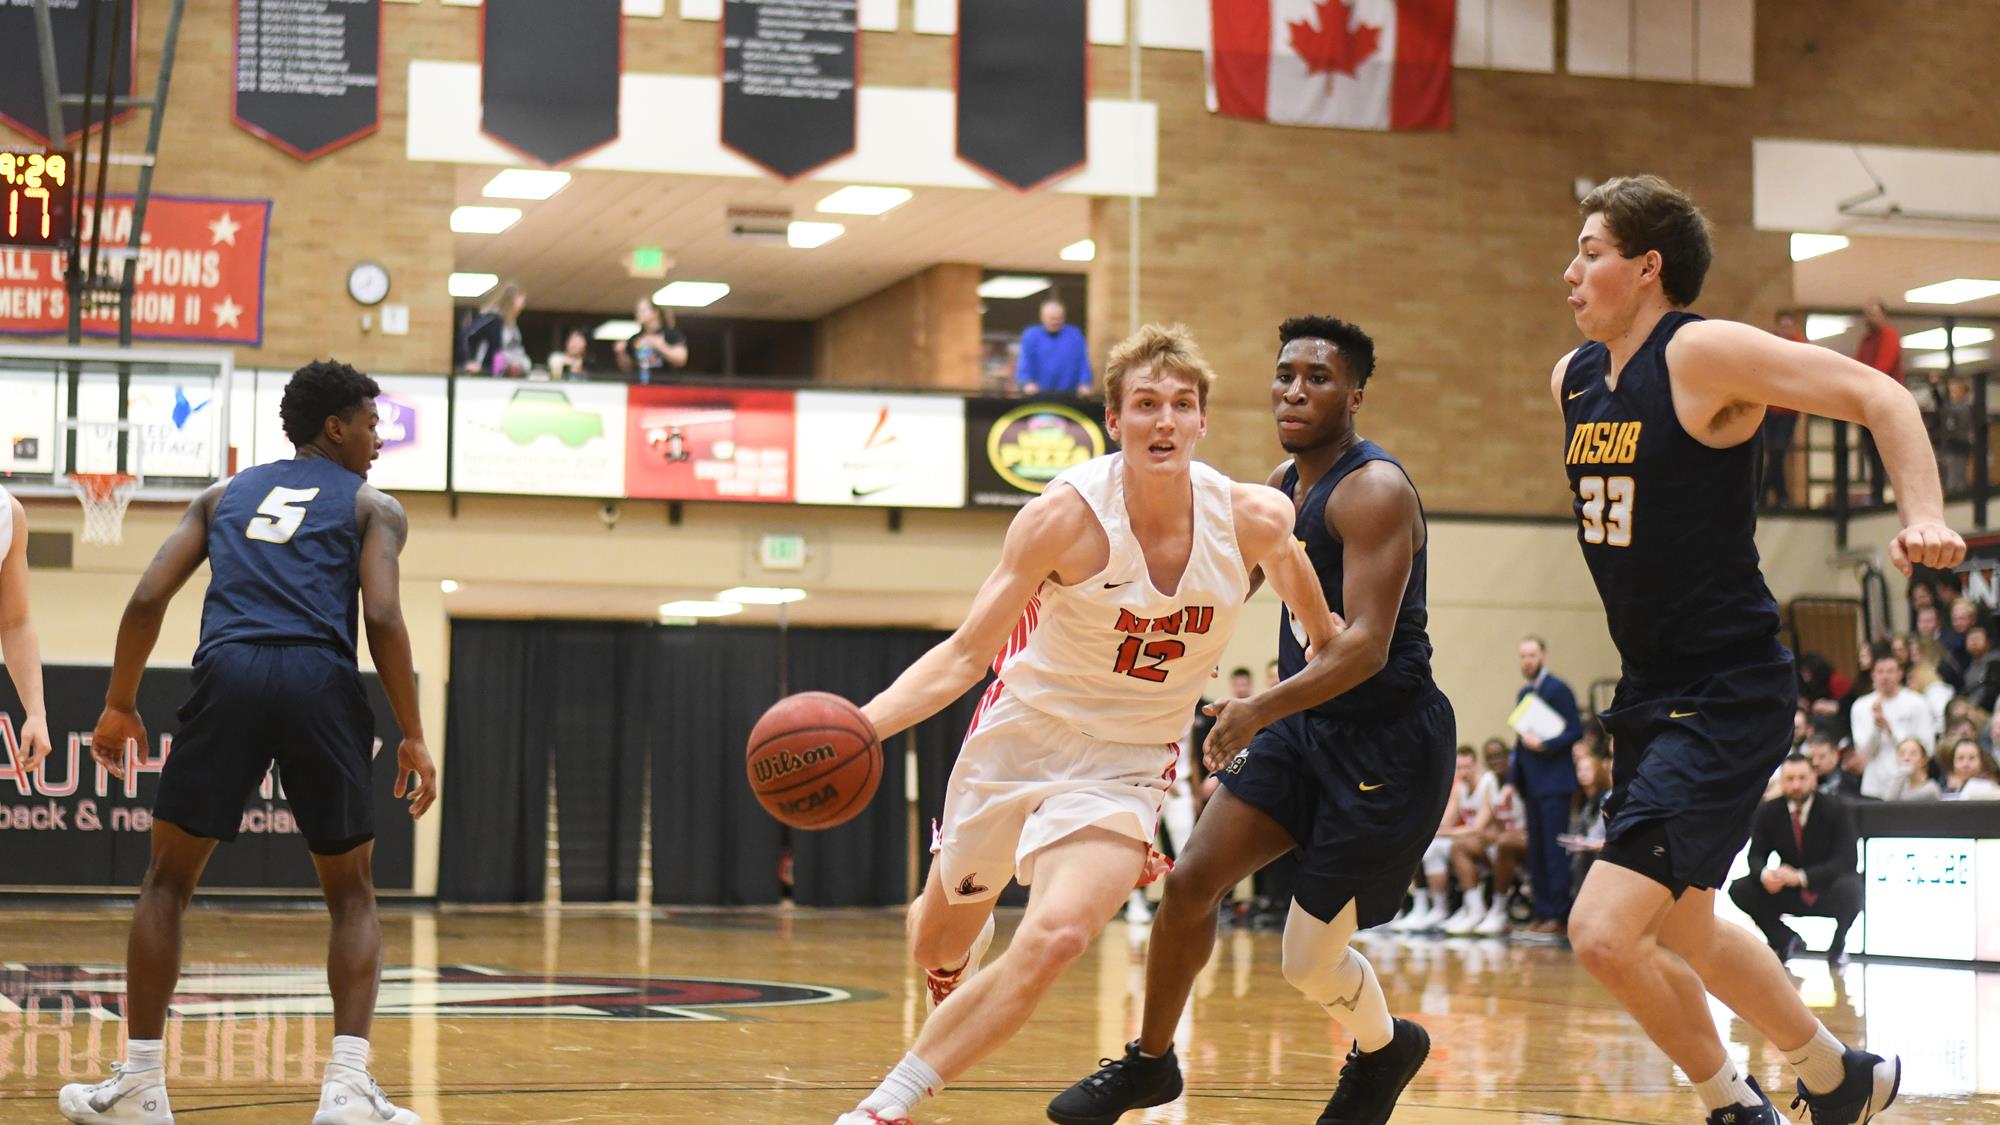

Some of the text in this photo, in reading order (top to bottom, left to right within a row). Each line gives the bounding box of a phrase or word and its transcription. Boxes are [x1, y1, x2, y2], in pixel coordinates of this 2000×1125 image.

[0, 152, 66, 187] 9:29
[8, 187, 50, 239] 17
[51, 248, 220, 288] CPIONS
[1565, 421, 1642, 465] MSUB
[245, 485, 321, 545] 5
[1579, 475, 1635, 547] 33
[1113, 605, 1215, 636] NNU
[1112, 634, 1186, 683] 12
[753, 743, 839, 783] Wilson
[775, 783, 839, 816] NCAA
